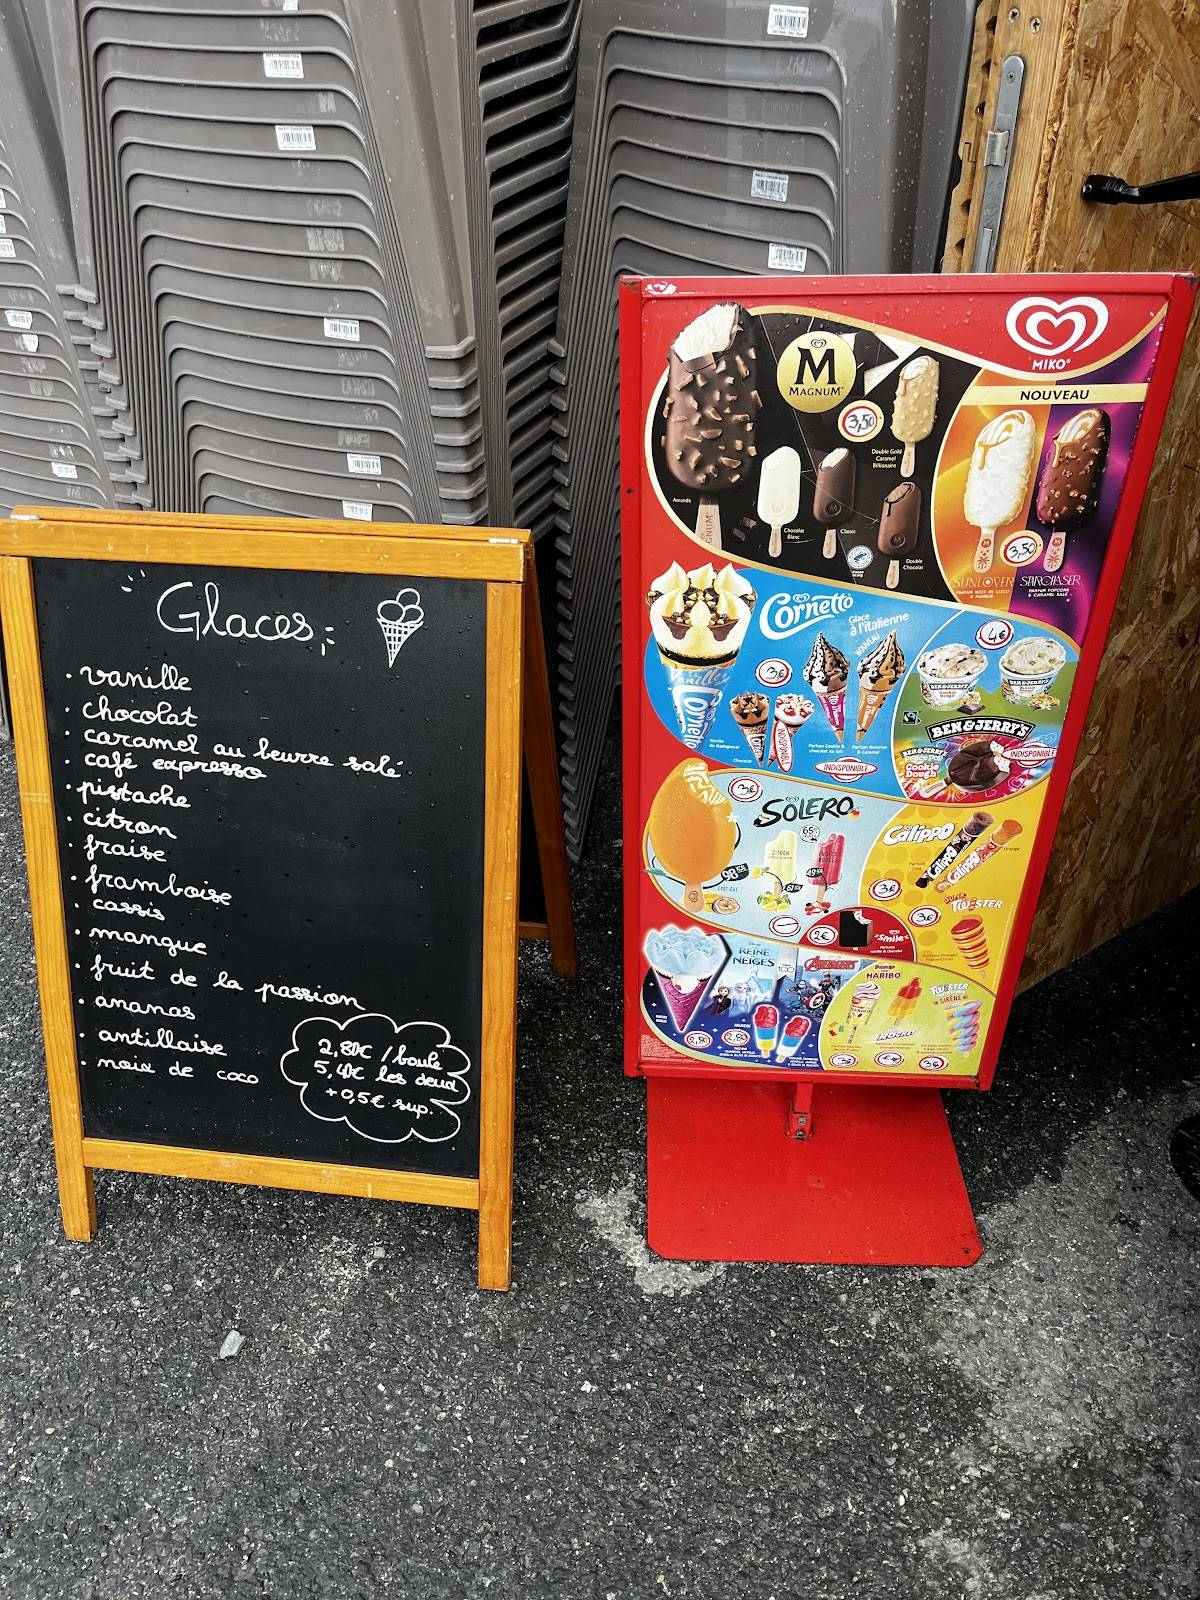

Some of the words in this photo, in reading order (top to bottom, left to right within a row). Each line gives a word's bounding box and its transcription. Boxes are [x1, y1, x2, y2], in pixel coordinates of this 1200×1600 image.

[797, 346, 837, 385] M
[788, 386, 841, 397] MAGNUM
[1020, 389, 1090, 401] NOUVEAU
[1009, 542, 1036, 559] 3,50
[156, 581, 315, 641] Glaces
[759, 592, 853, 640] Cornetto
[848, 613, 871, 625] Glace
[858, 612, 909, 634] l'italienne
[854, 632, 880, 657] NOUVEAU
[80, 663, 193, 692] vanille
[82, 696, 199, 727] chocolat
[84, 730, 200, 755] caramel
[213, 740, 246, 759] au
[254, 738, 334, 767] beurre
[343, 756, 402, 779] salé
[84, 752, 138, 771] café
[152, 757, 267, 780] expresso
[823, 763, 869, 772] INDISPONIBLE
[905, 763, 939, 771] Cookie
[905, 770, 937, 779] Dough
[77, 777, 192, 808] pistache
[82, 810, 178, 839] citron
[883, 822, 955, 846] Calippo
[83, 833, 168, 862] fraise
[927, 846, 957, 879] Calippo
[947, 851, 980, 884] Calippo
[85, 864, 233, 906] framboise
[92, 898, 166, 921] cassis
[89, 926, 208, 956] mangue
[814, 930, 829, 942] 2€
[732, 957, 775, 967] NEIGES
[739, 947, 770, 956] REINE
[89, 954, 156, 981] fruit
[170, 967, 198, 987] de
[213, 971, 244, 991] la
[254, 981, 366, 1011] passion
[95, 994, 196, 1020] ananas
[98, 1028, 228, 1057] antillaise
[97, 1057, 156, 1075] noix
[168, 1061, 195, 1077] de
[216, 1068, 260, 1085] coco
[375, 1065, 408, 1085] les
[414, 1072, 460, 1093] deux
[392, 1098, 434, 1119] sup.
